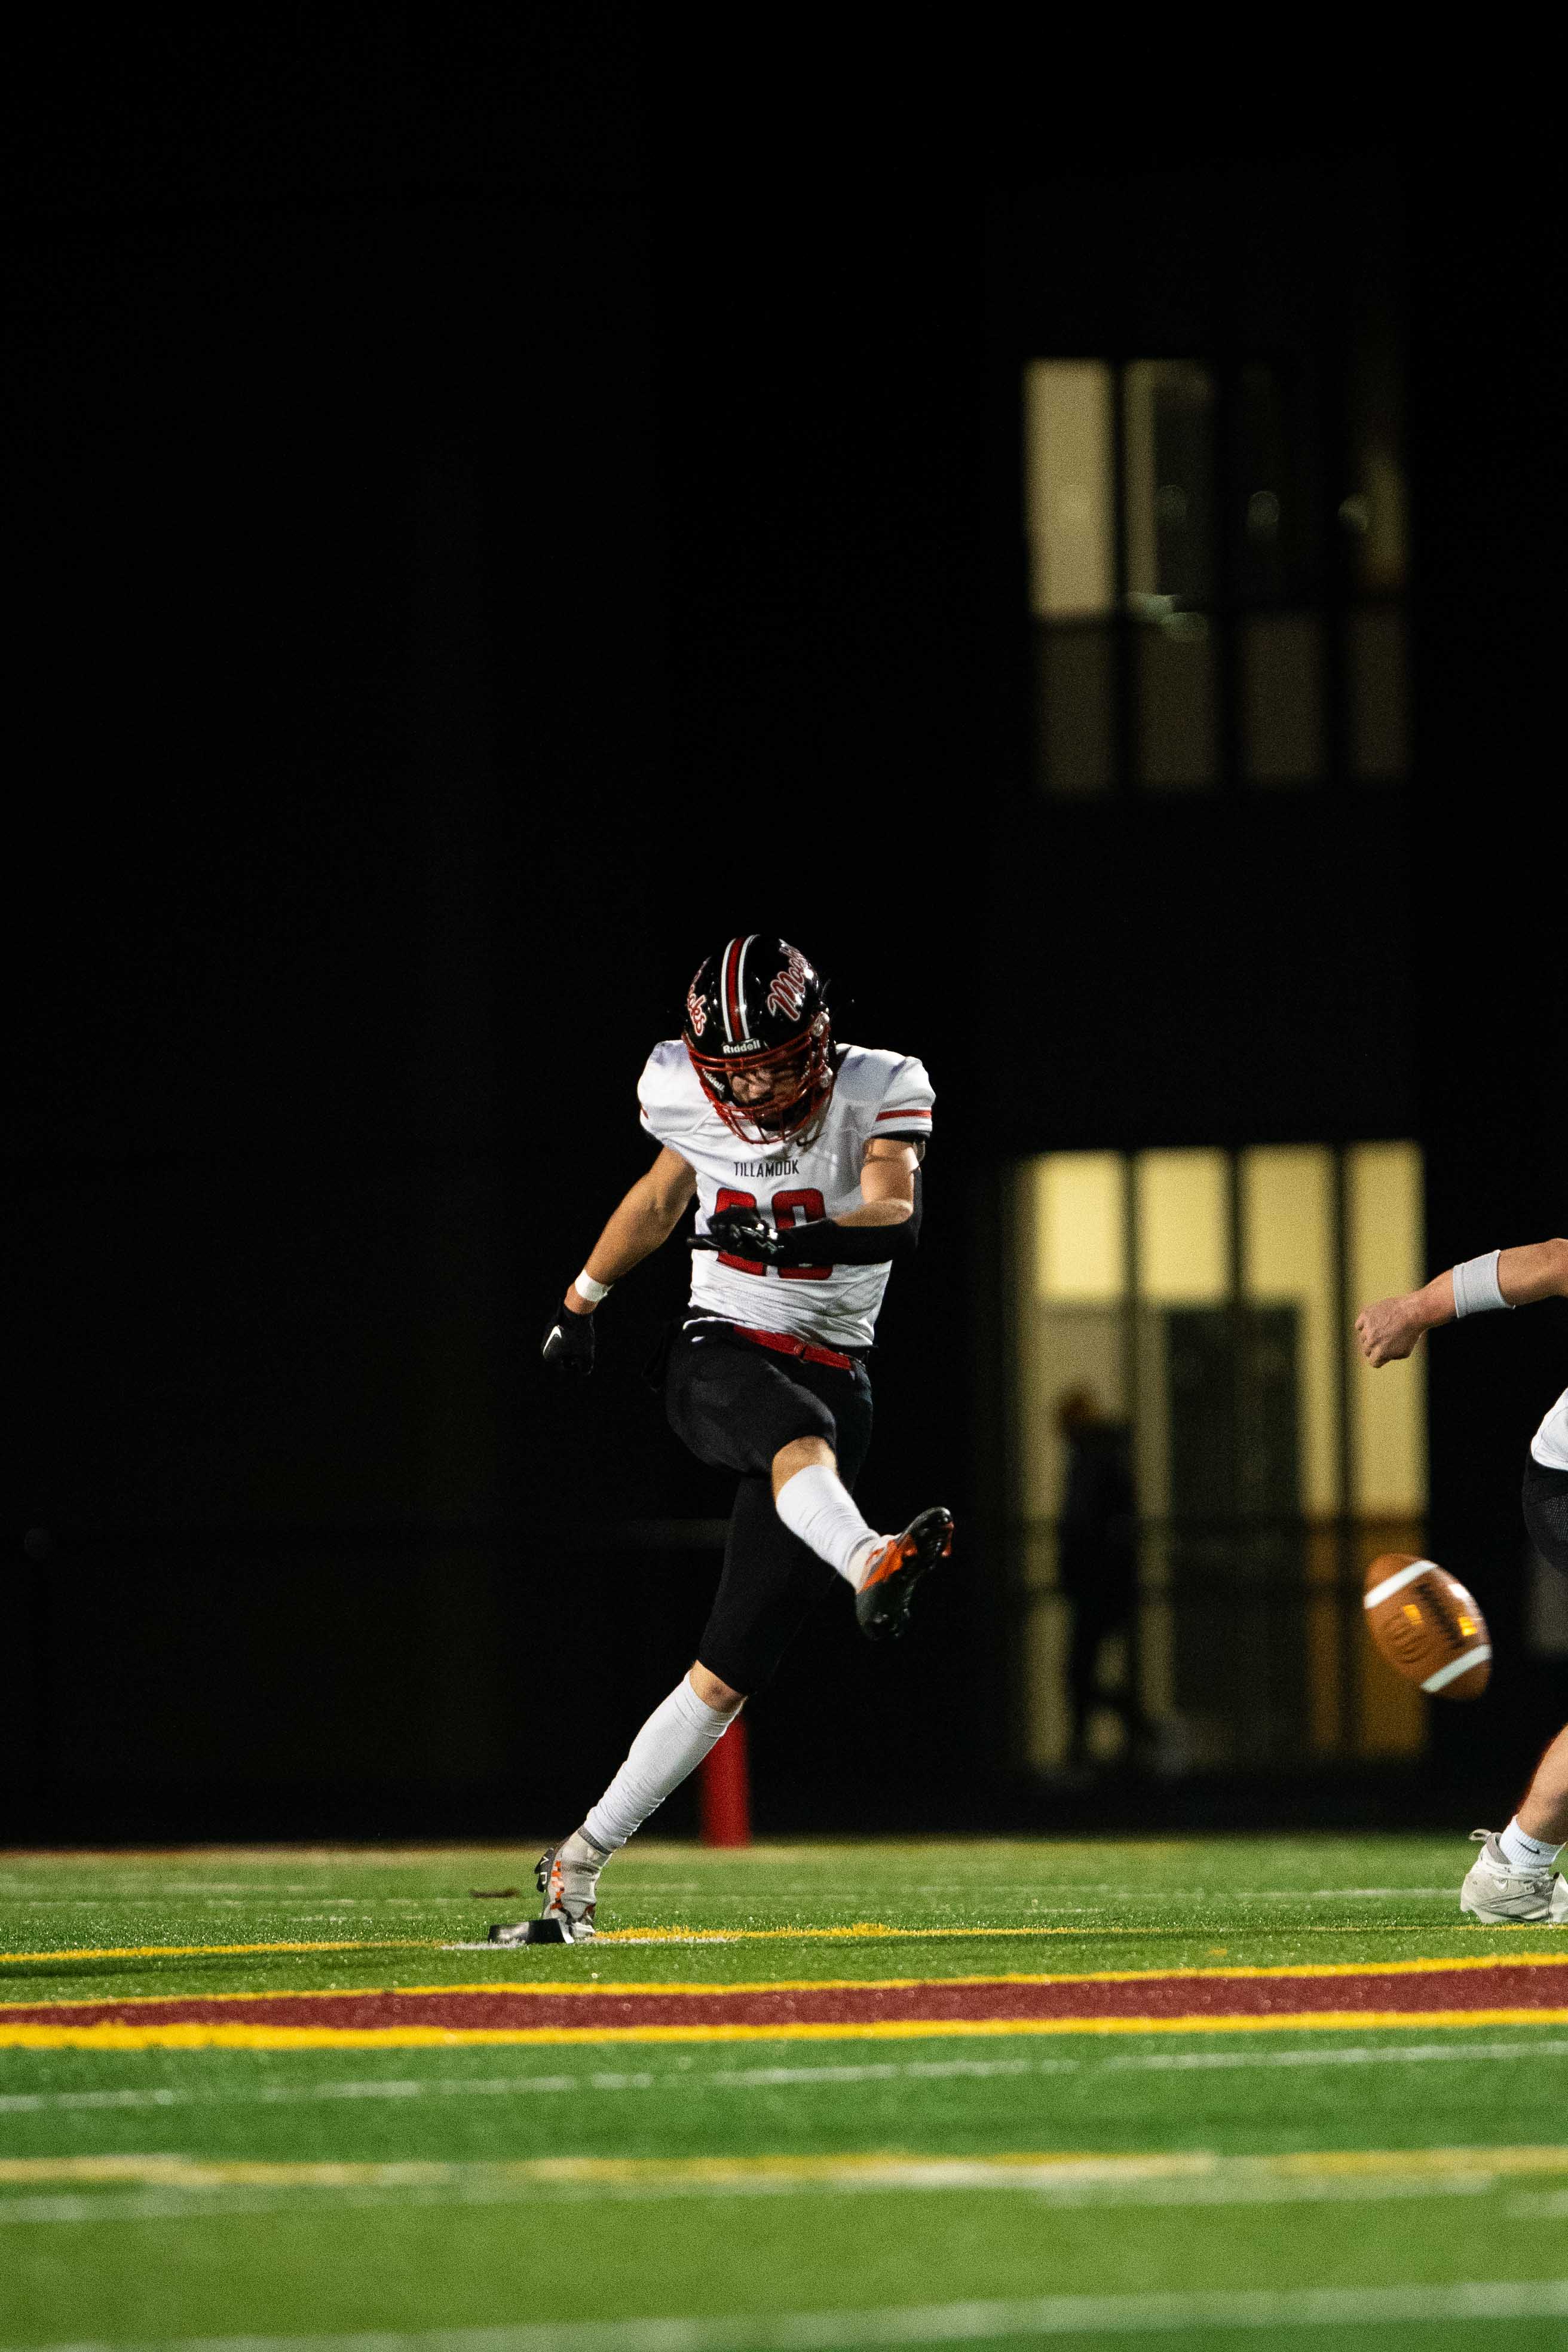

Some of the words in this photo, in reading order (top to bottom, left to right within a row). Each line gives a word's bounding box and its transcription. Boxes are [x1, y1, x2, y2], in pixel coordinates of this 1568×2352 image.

[767, 939, 811, 1021] Moo
[722, 1040, 761, 1054] Riddell
[702, 1067, 725, 1093] iddell
[733, 1160, 800, 1177] TILLAMOOK
